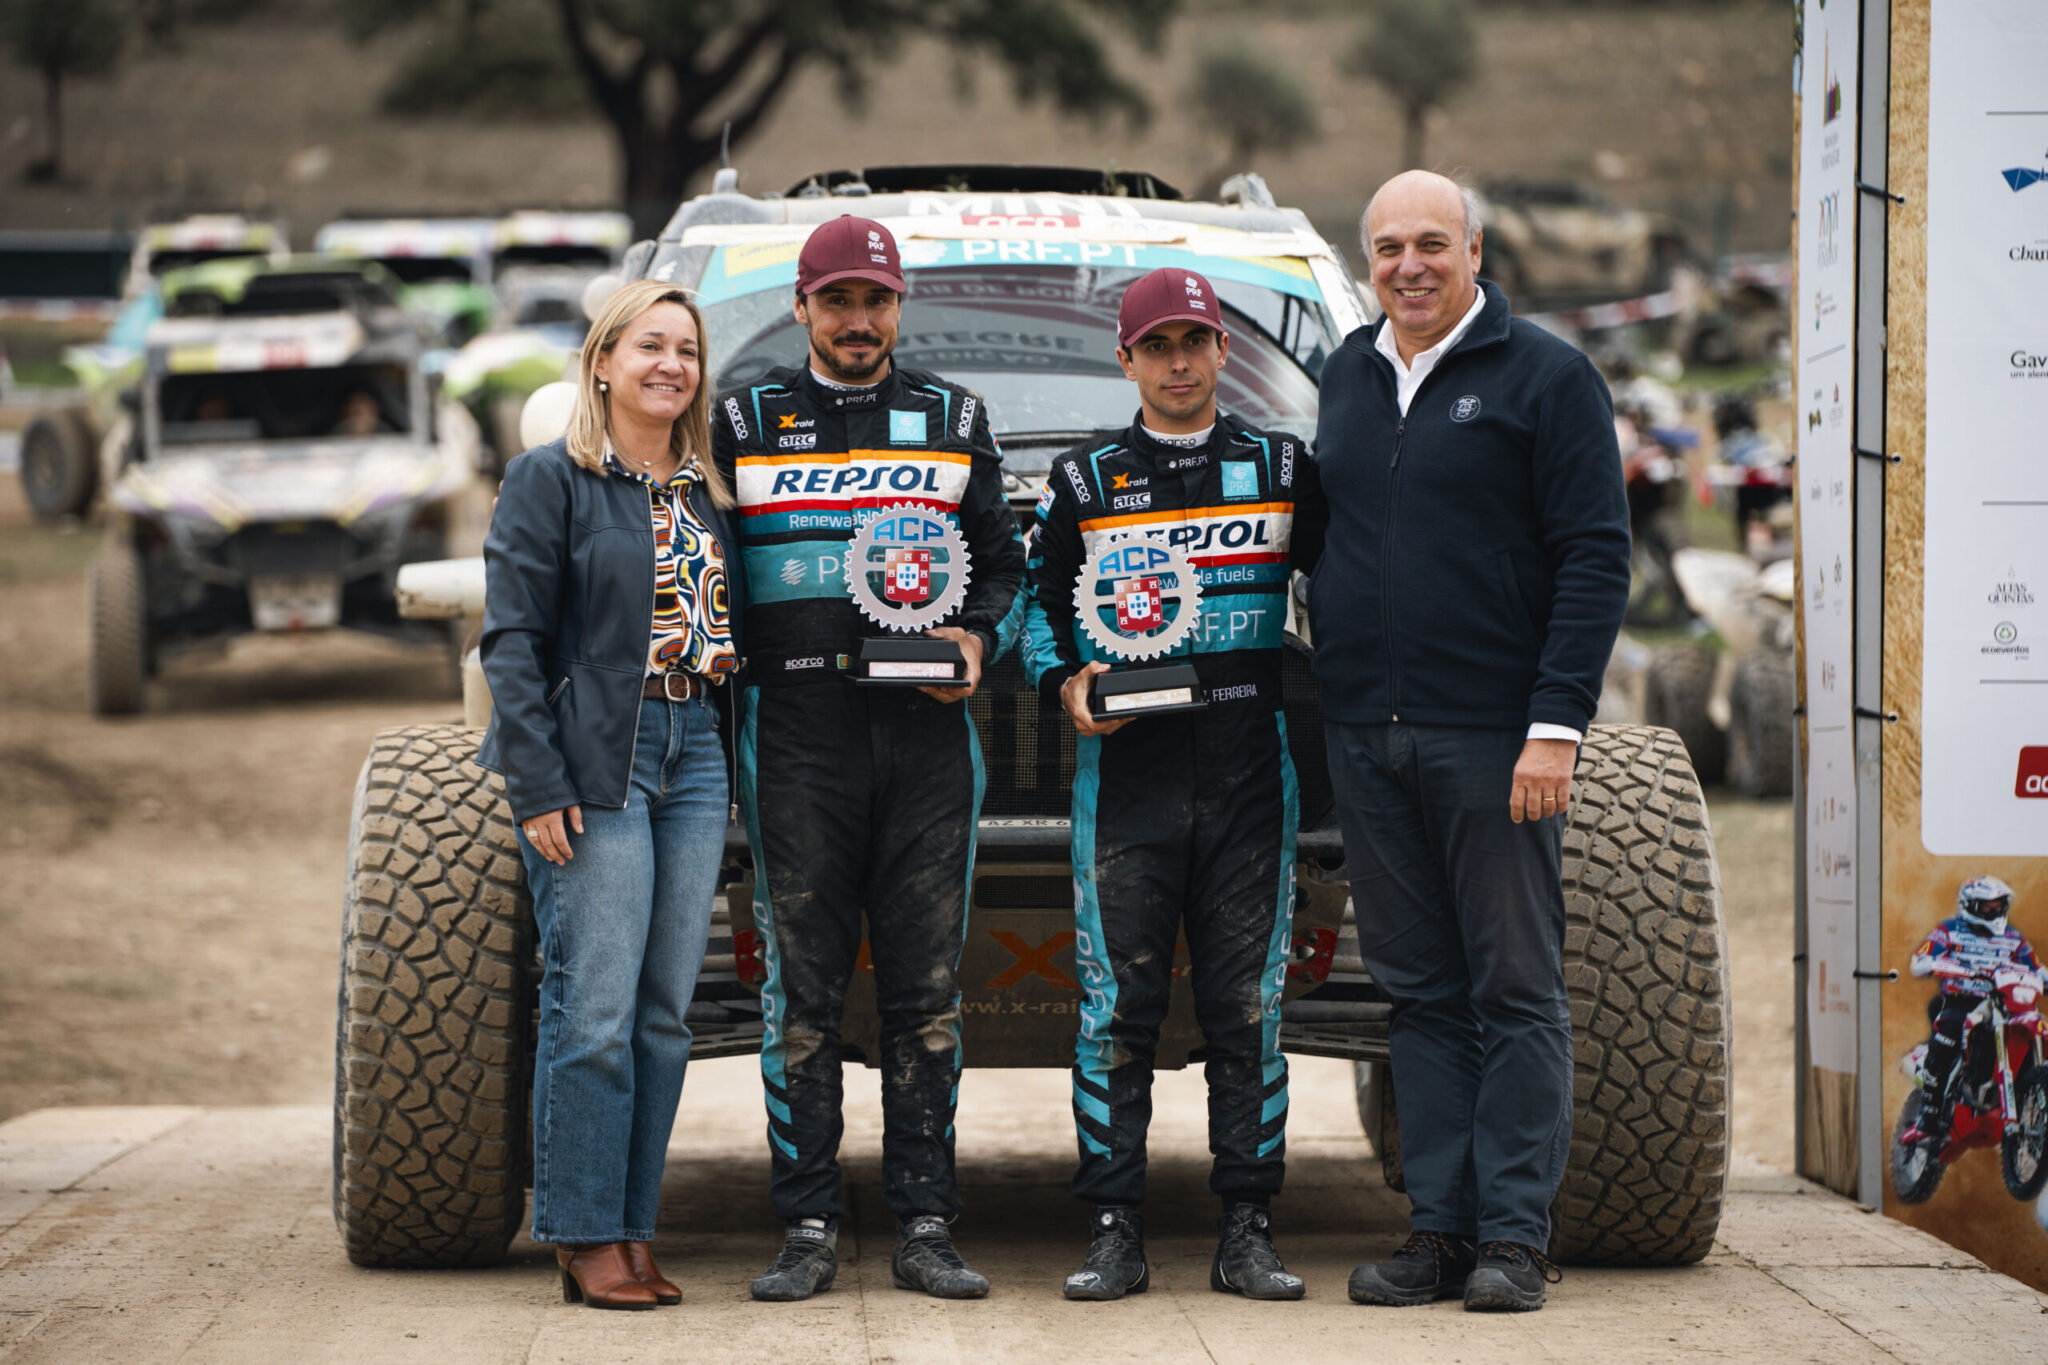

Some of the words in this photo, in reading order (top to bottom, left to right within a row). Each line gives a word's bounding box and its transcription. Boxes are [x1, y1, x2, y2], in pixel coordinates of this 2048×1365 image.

[962, 239, 1146, 267] PRF.PT
[846, 393, 878, 405] PRF.PT
[724, 397, 748, 441] sparco
[957, 397, 976, 440] sparco
[1154, 437, 1197, 448] parco
[1178, 454, 1209, 469] PRF.PT
[1281, 442, 1294, 488] sparco
[771, 465, 940, 496] REPSOL
[1063, 460, 1091, 504] sparco
[789, 510, 874, 529] Renewabl
[873, 517, 945, 542] ACP
[1110, 519, 1270, 551] PSOL
[1098, 546, 1171, 575] ACP
[1216, 566, 1256, 583] fuels
[784, 656, 825, 670] sparco
[1212, 684, 1258, 702] FERREIRA
